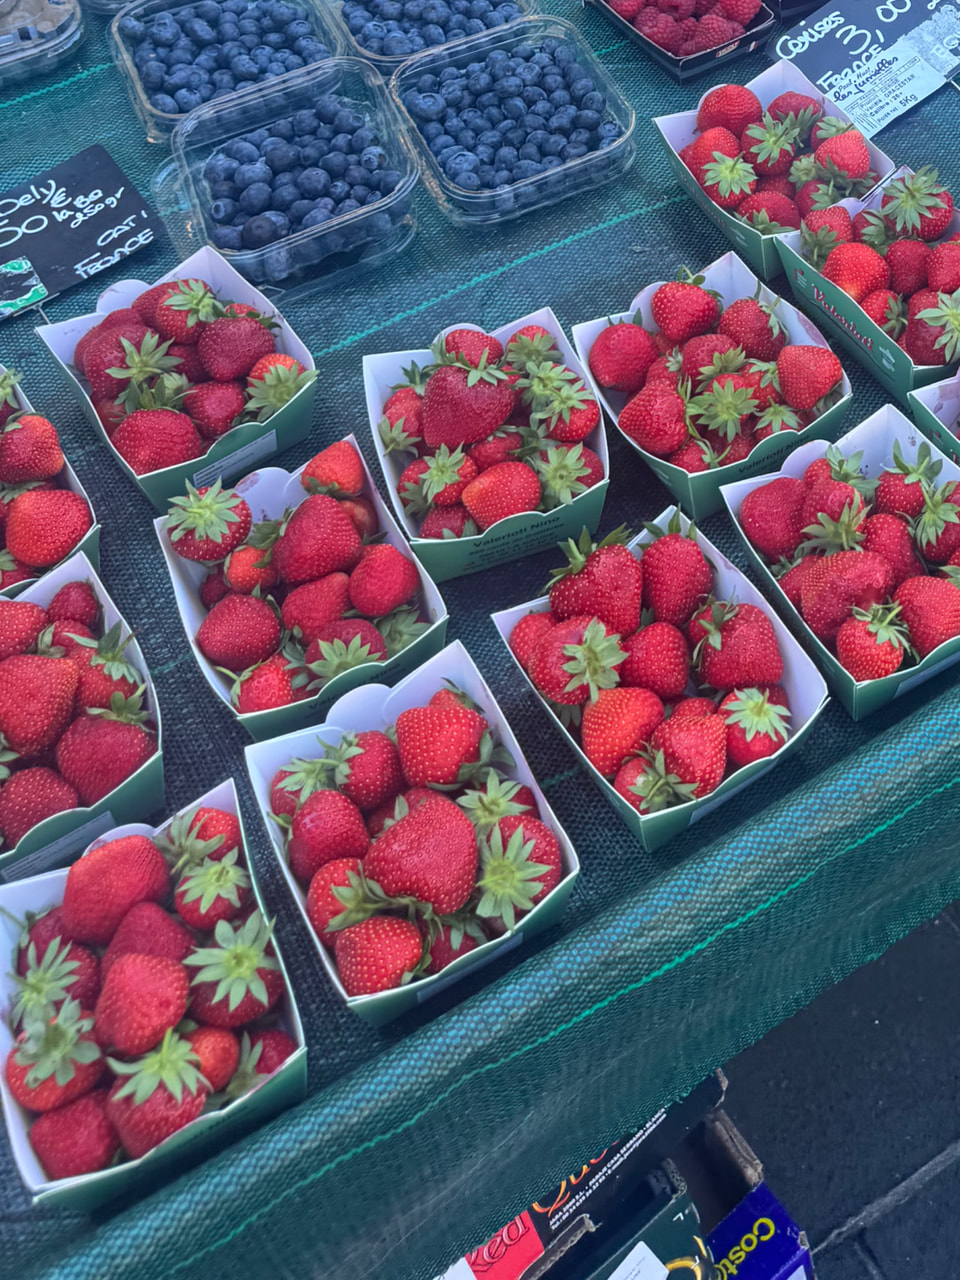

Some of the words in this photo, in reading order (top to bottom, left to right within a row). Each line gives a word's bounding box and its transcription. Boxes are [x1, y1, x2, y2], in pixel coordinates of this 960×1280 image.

[899, 93, 919, 108] 5Kg
[50, 187, 72, 208] €
[73, 228, 155, 280] FRANCE
[811, 283, 874, 352] Valerioti
[785, 435, 811, 450] Nino
[472, 527, 527, 547] Valerioti
[529, 516, 560, 529] Nino
